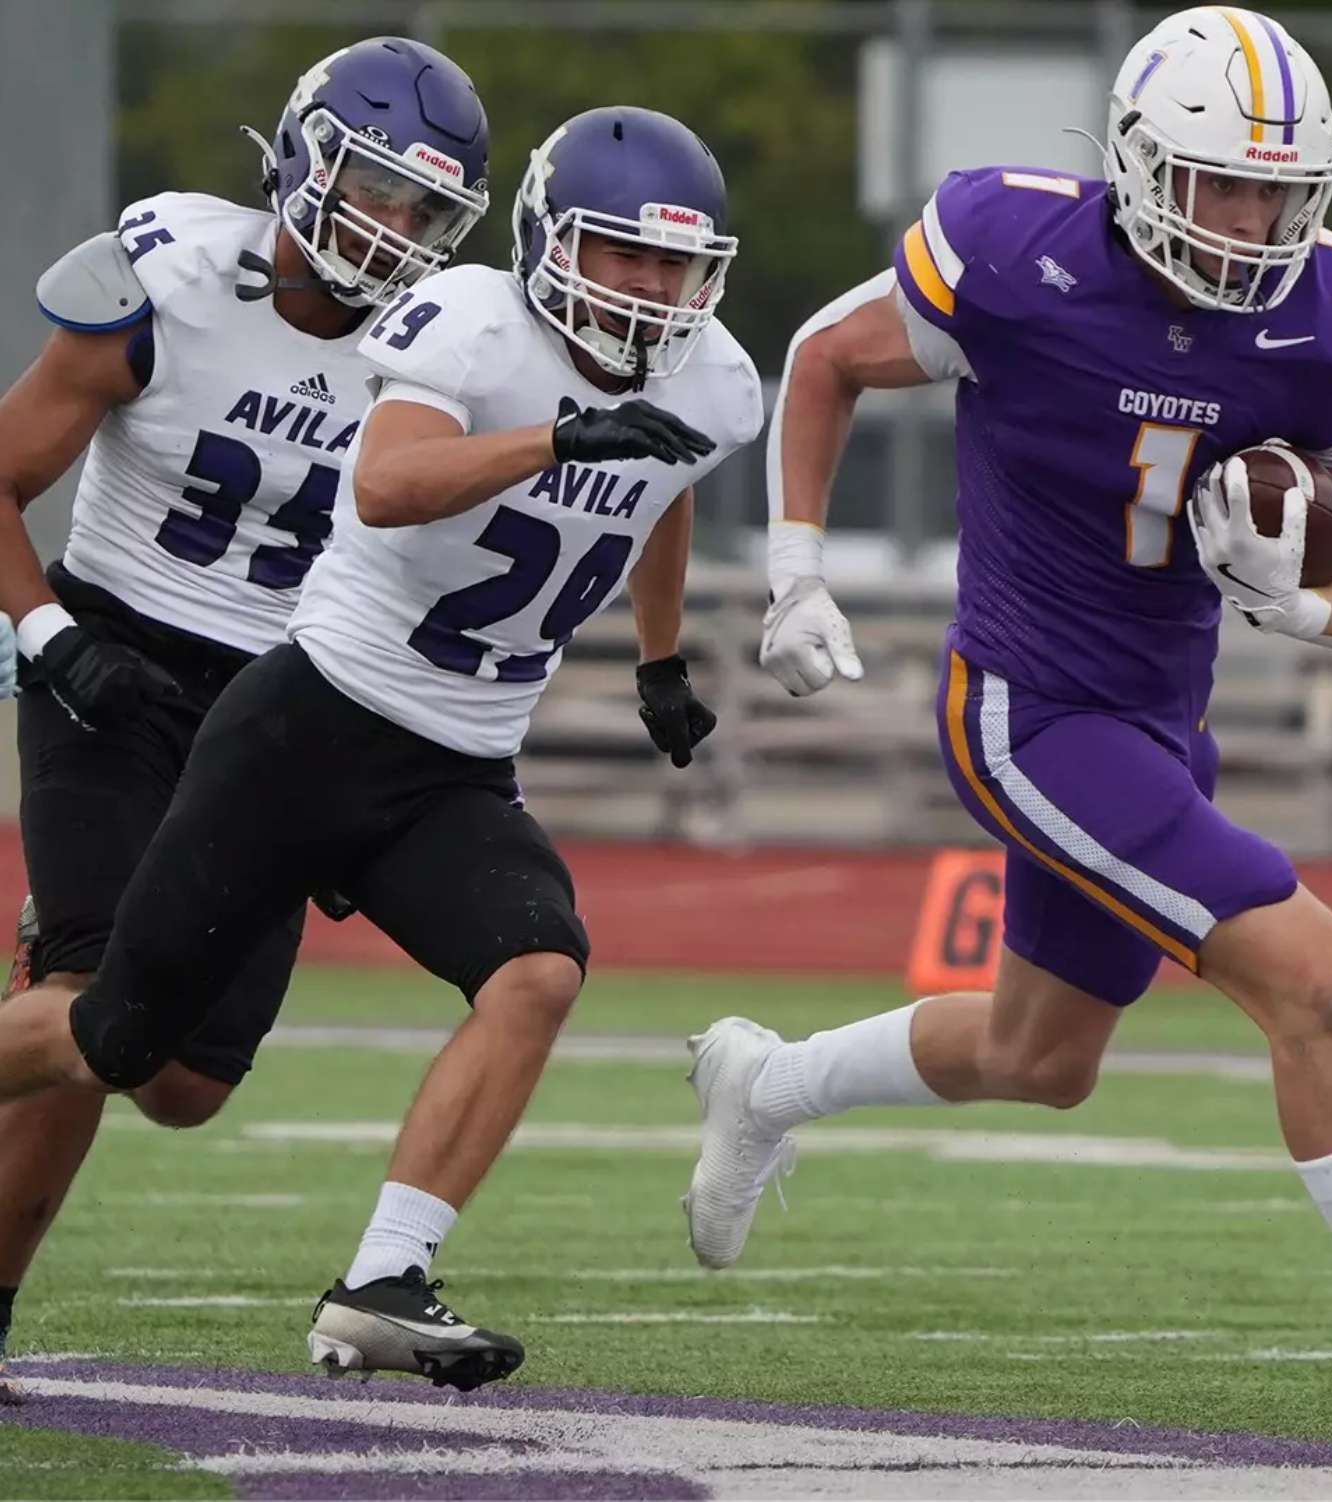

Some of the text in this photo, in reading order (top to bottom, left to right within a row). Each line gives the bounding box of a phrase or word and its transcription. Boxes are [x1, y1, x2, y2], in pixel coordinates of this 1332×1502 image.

[415, 148, 461, 178] Riddell
[1245, 147, 1299, 163] Riddell
[658, 207, 698, 226] Riddell
[290, 383, 337, 405] adidas
[1117, 388, 1222, 425] COYOTES
[527, 463, 649, 519] AVILA
[1125, 421, 1203, 568] 1
[406, 504, 634, 683] 29
[941, 871, 1002, 968] G
